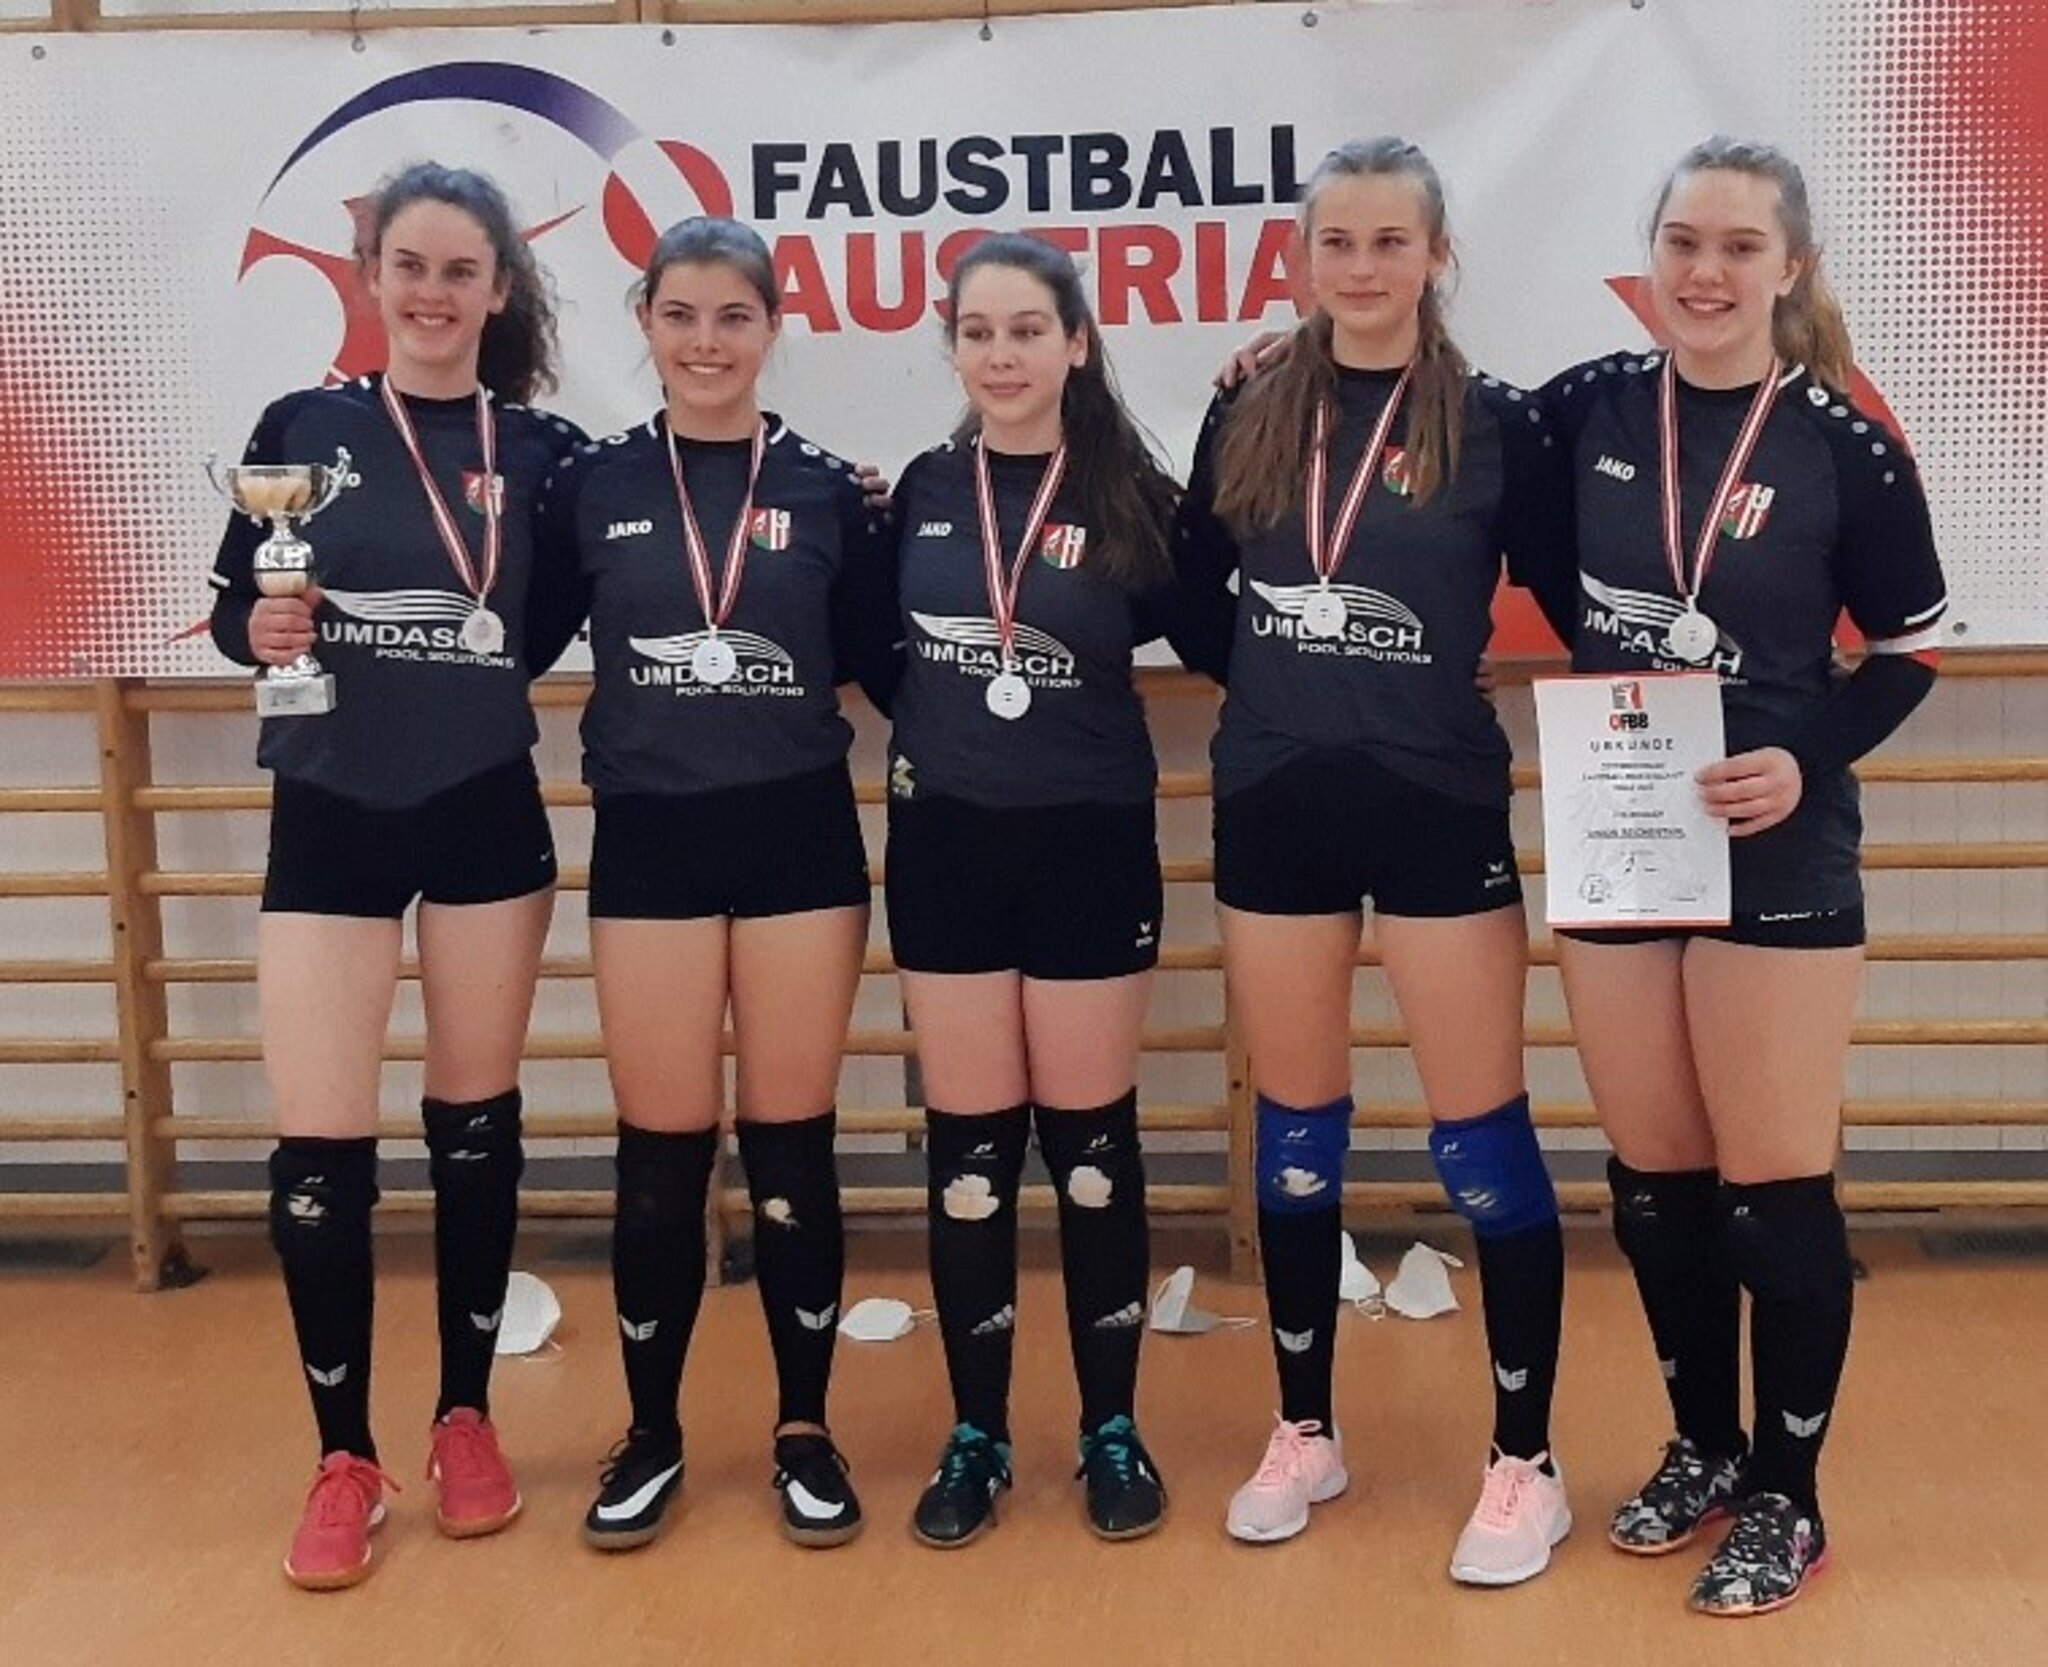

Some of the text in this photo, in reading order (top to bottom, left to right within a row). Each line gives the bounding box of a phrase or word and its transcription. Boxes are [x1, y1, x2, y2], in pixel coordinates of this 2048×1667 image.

[752, 124, 1306, 219] FAUSTBALL
[1594, 454, 1636, 482] JAKO
[606, 520, 653, 540] JAKO
[917, 521, 952, 537] JAKO
[321, 621, 504, 654] UMDAS
[1590, 737, 1675, 753] URKUNDE
